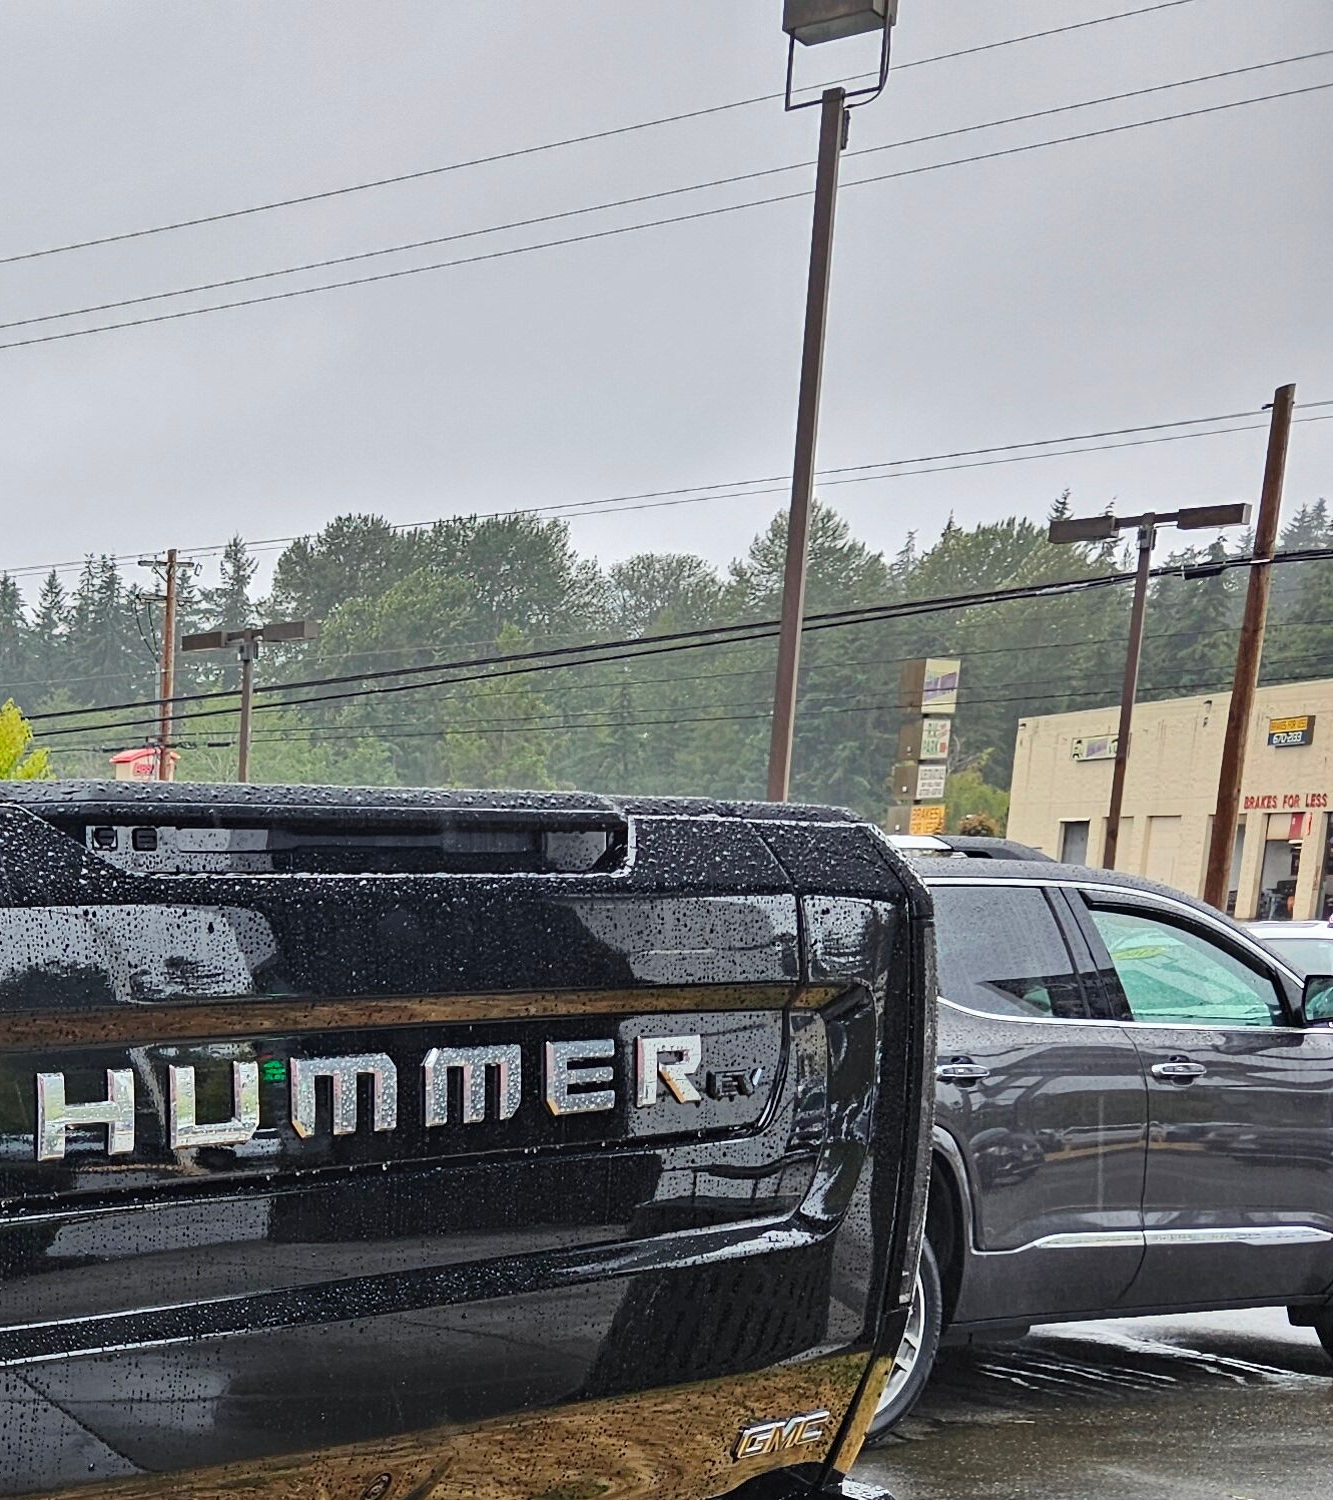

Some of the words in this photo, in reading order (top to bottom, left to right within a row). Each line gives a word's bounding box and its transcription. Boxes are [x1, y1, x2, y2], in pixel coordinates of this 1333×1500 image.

[1244, 795, 1278, 810] BRAKES
[1282, 794, 1300, 809] FOR
[1305, 793, 1328, 808] LESS
[35, 1033, 702, 1162] HUMMER
[733, 1410, 831, 1460] GMC
